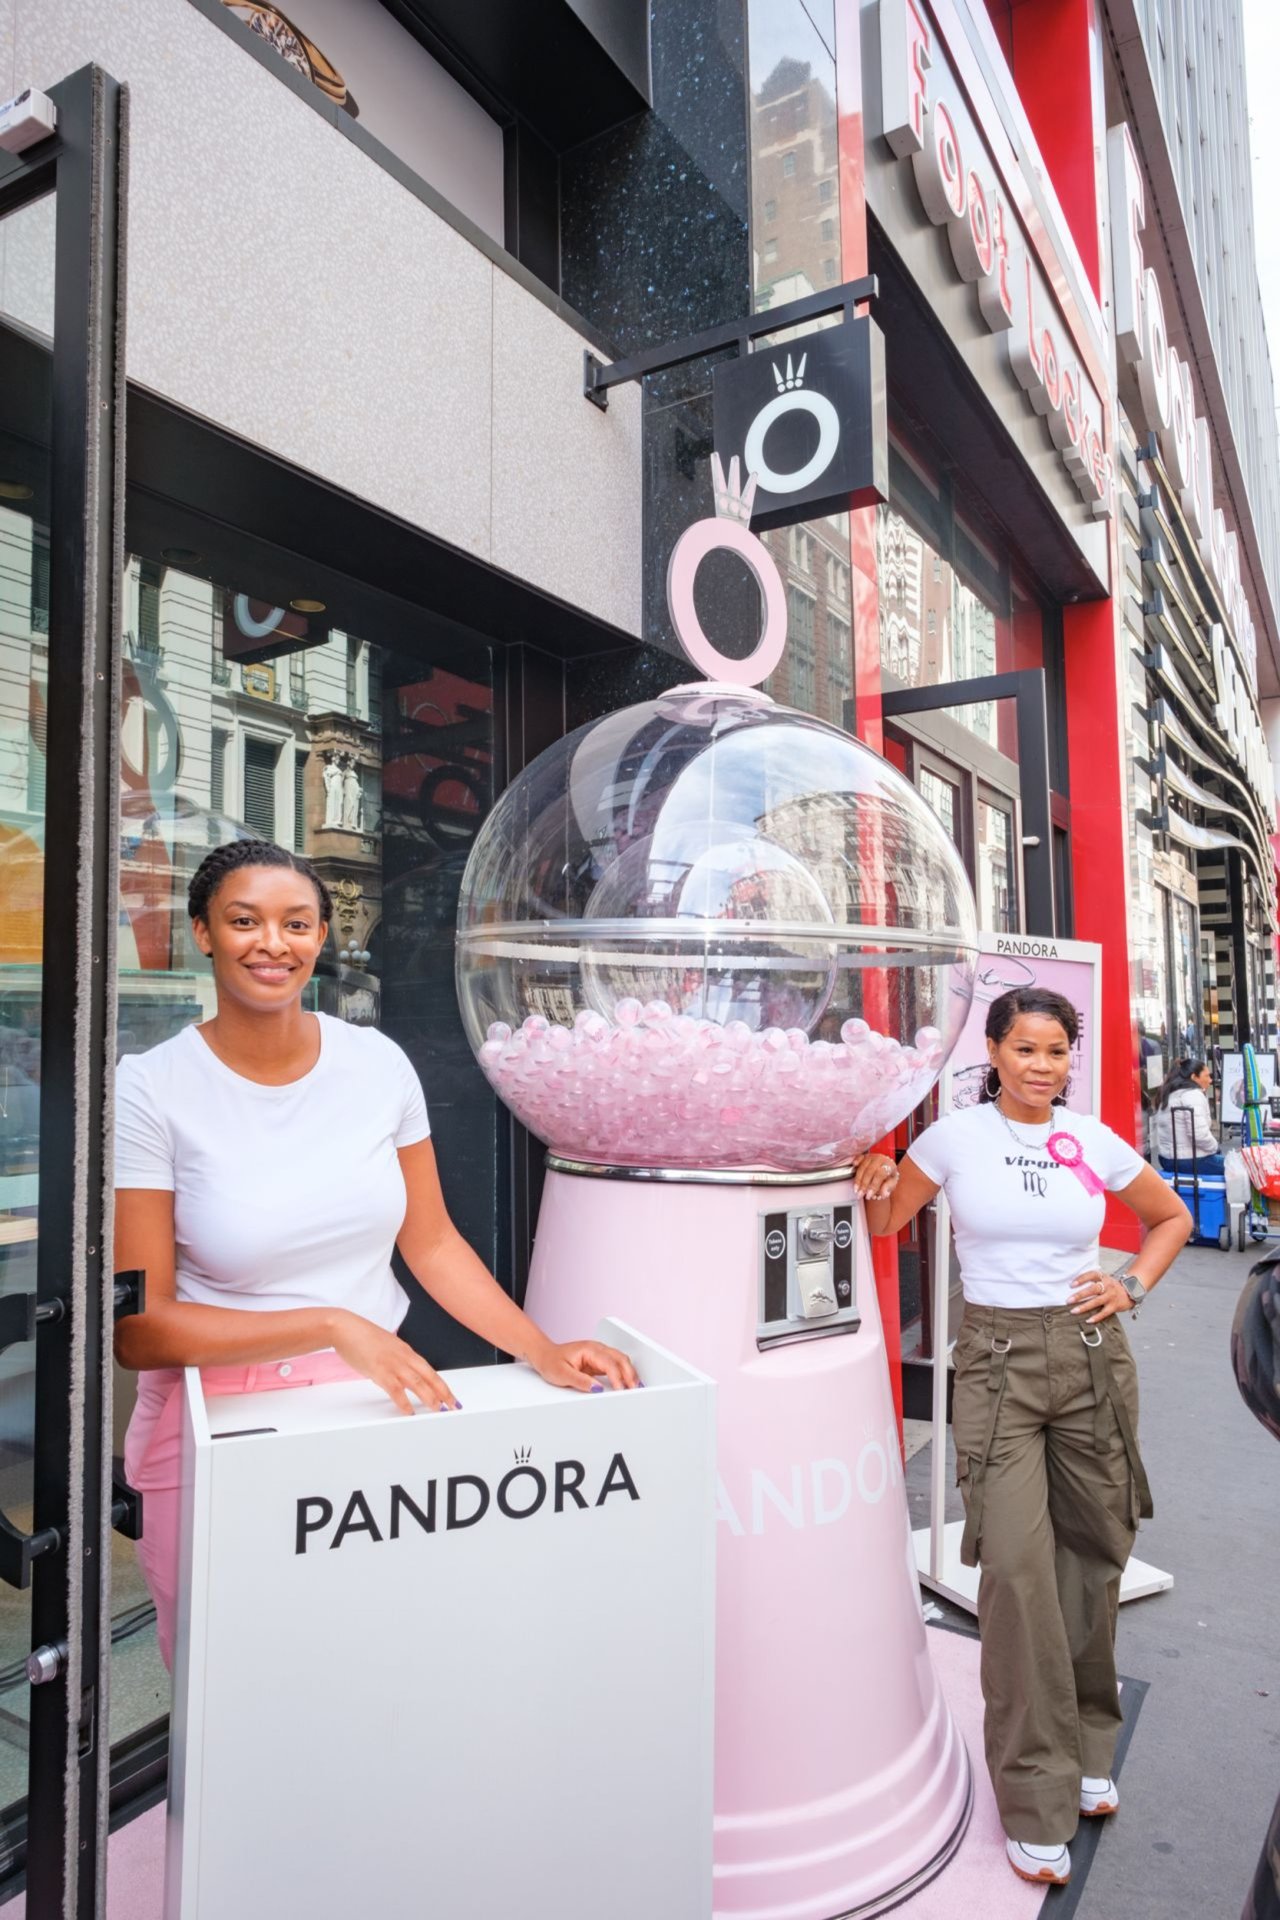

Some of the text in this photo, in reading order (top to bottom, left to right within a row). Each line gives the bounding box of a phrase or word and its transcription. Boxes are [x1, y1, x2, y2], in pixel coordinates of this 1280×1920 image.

[880, 0, 1012, 332] Foot
[997, 939, 1059, 958] PANDORA
[295, 1450, 641, 1556] PANDORA
